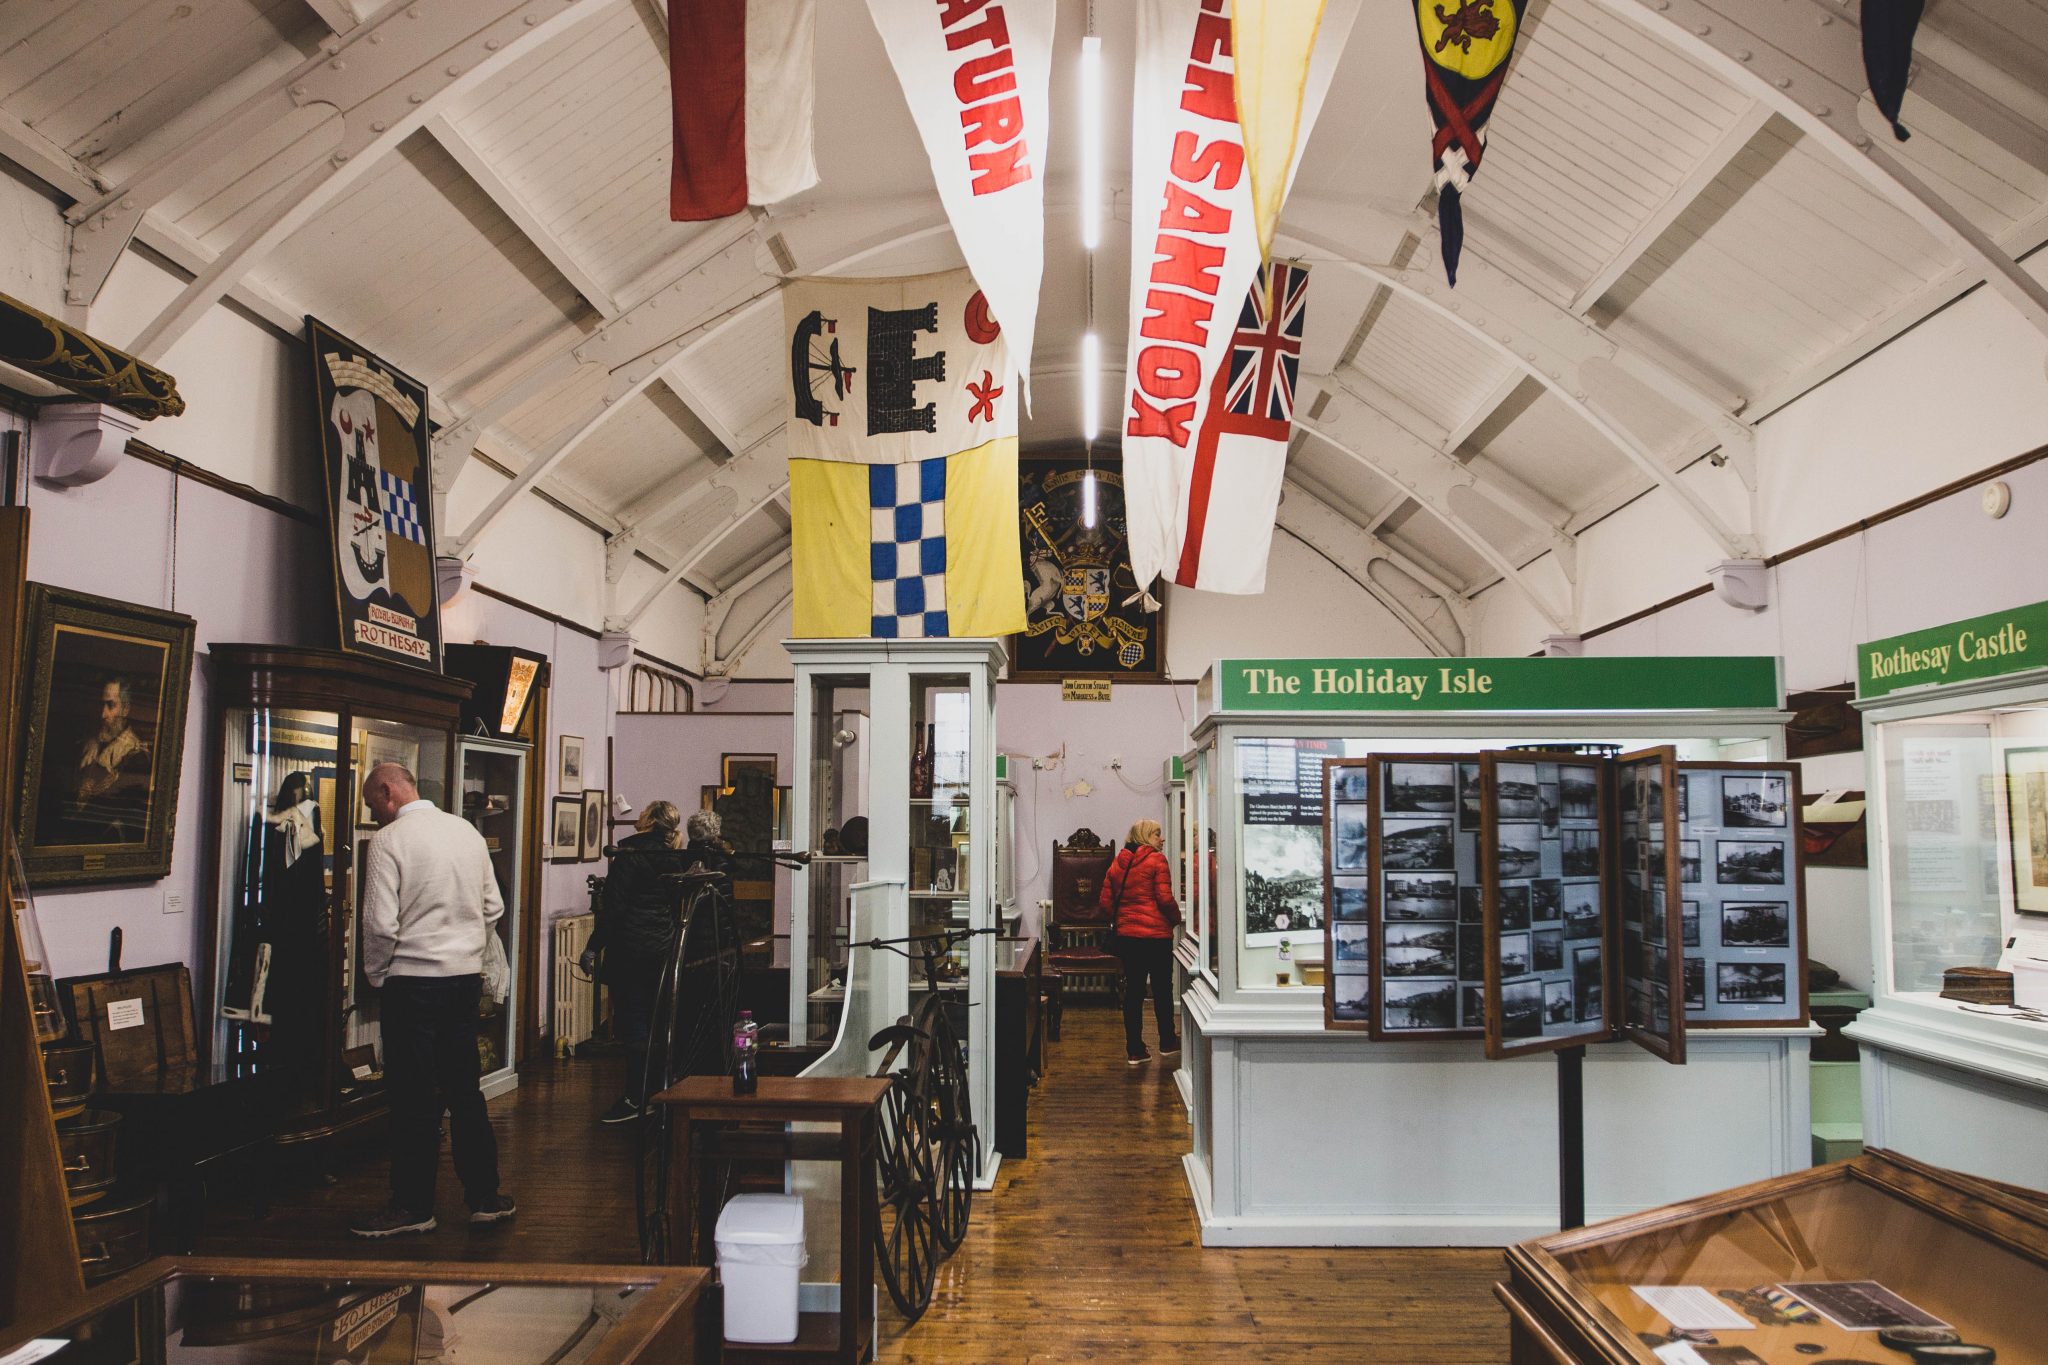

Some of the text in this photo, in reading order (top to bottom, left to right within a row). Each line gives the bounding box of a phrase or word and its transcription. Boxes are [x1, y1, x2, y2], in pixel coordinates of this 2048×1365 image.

[1127, 130, 1245, 448] SANNOX
[360, 623, 426, 656] ROTHESAY
[1870, 622, 2028, 679] Rothesay Castle
[1243, 668, 1493, 701] The Holiday Isle
